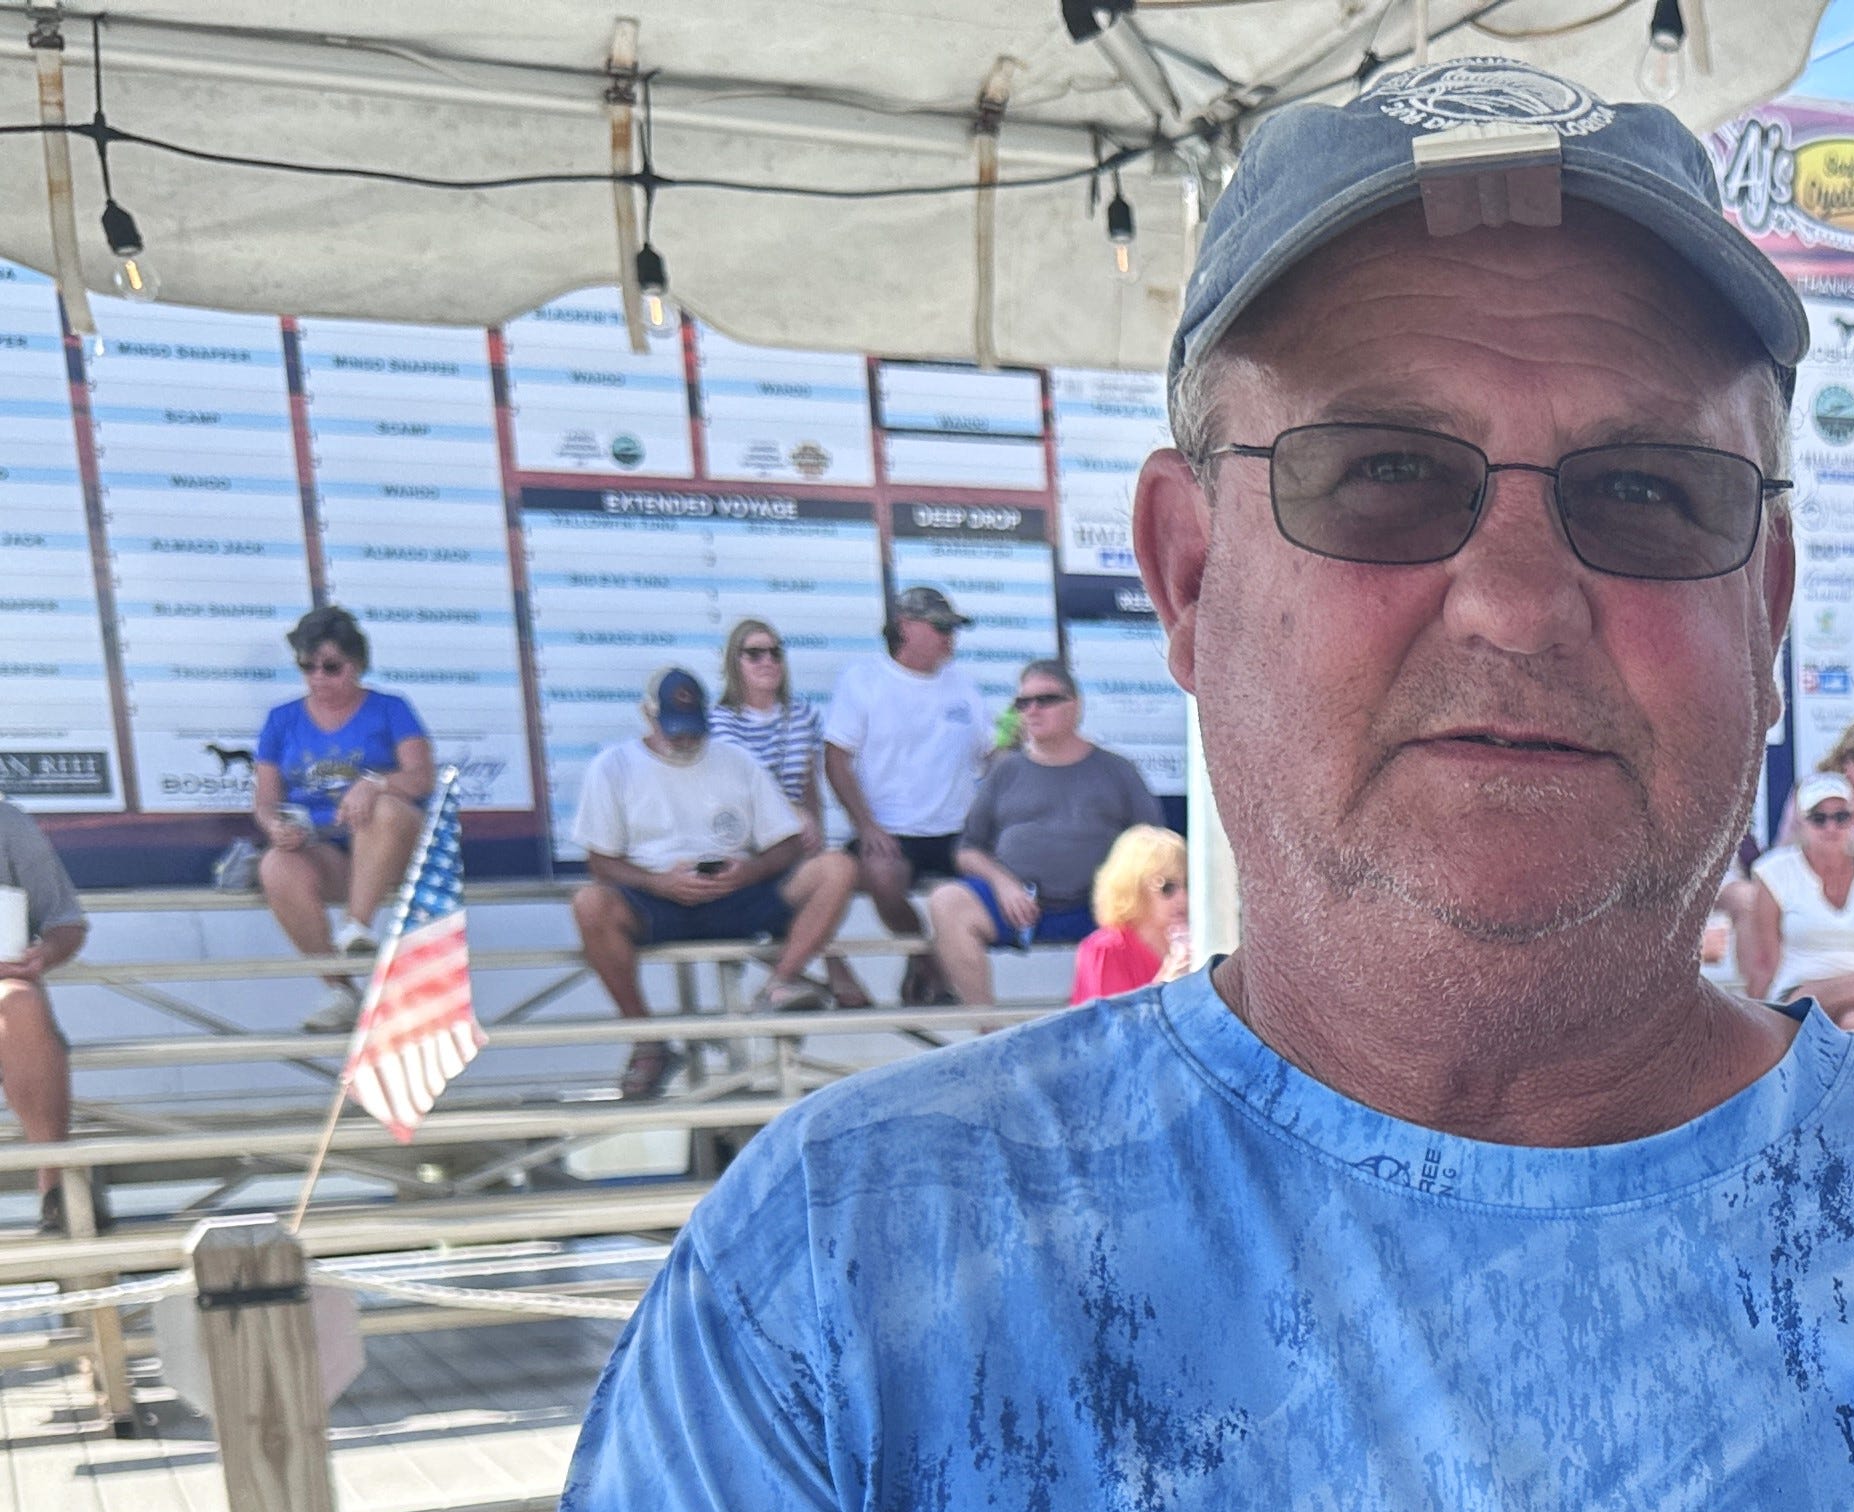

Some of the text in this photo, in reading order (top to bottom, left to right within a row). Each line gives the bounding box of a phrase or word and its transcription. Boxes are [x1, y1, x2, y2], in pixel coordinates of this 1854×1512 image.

[603, 489, 799, 519] EXTENDED VOYAGE
[912, 503, 1022, 531] DEEP DROP
